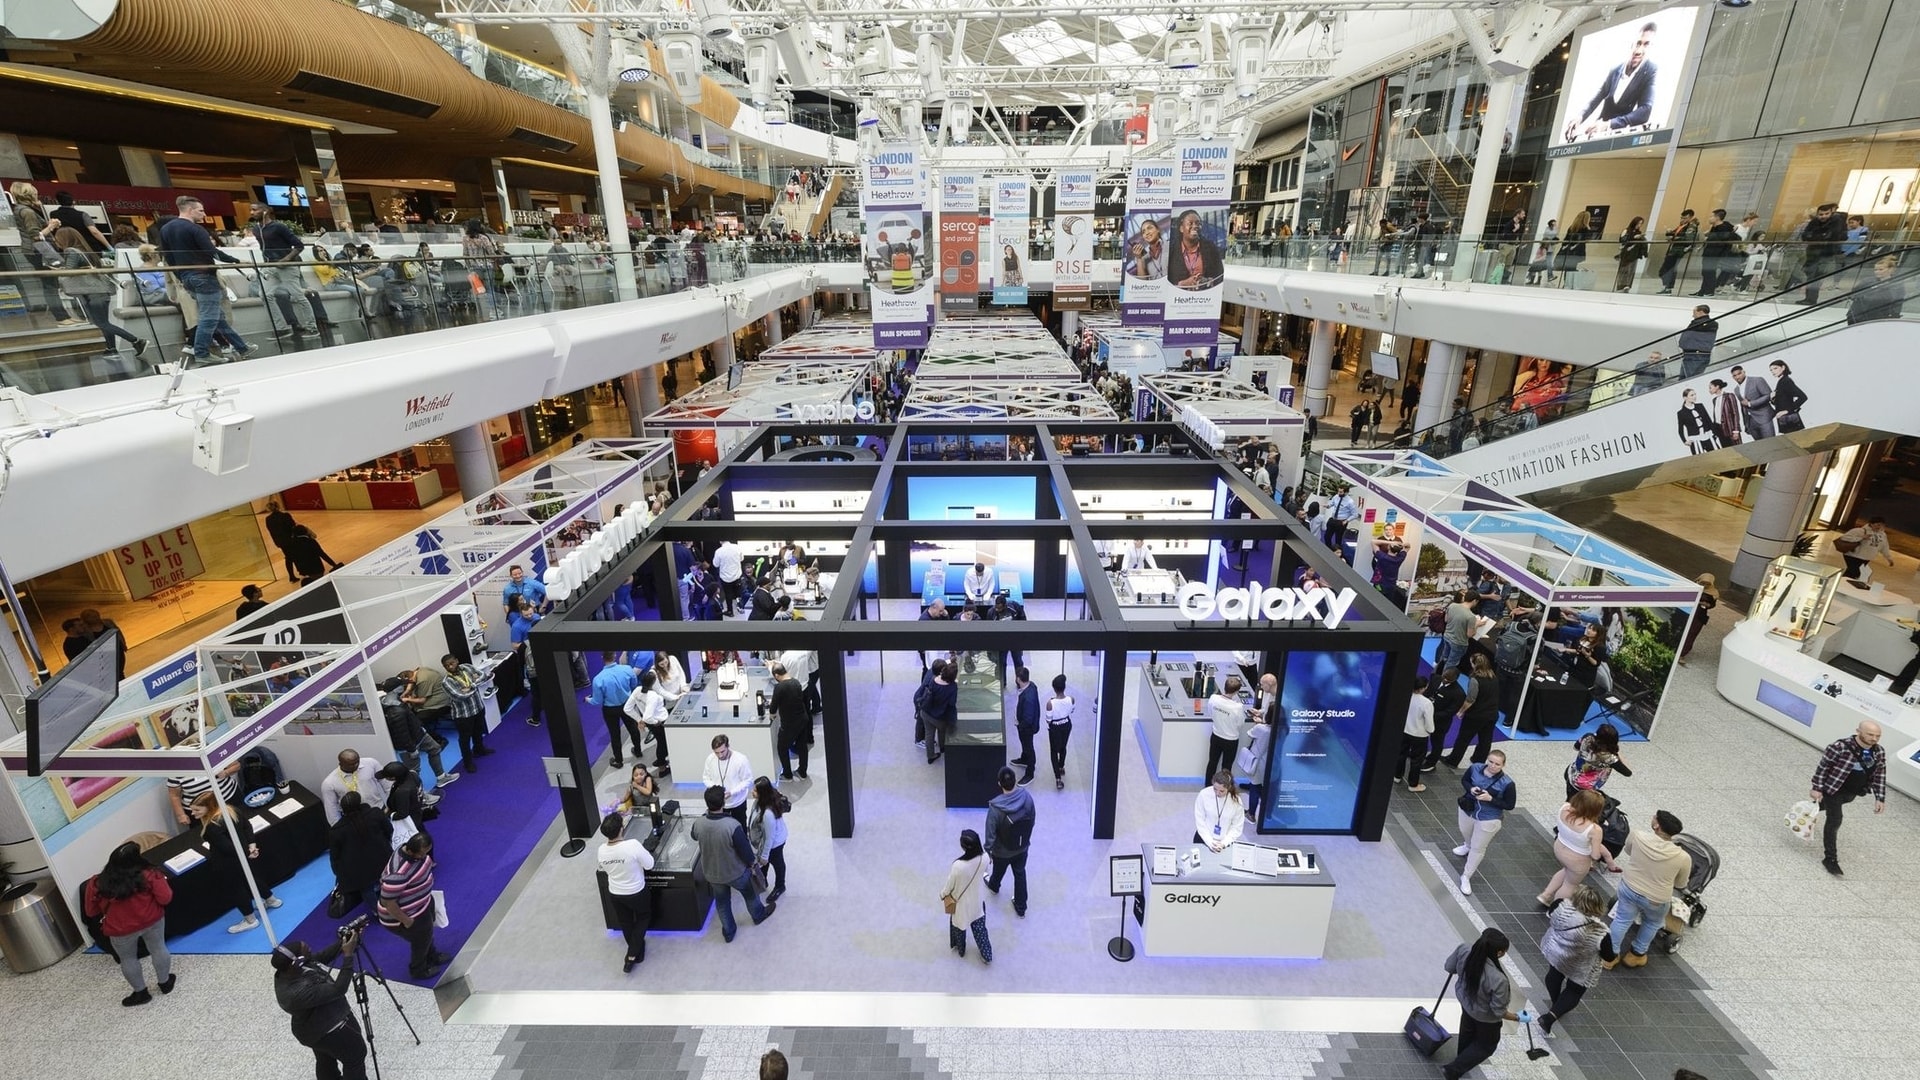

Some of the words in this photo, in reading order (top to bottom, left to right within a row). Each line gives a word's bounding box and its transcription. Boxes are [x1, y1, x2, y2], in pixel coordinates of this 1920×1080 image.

[1183, 147, 1228, 160] LONDON
[1550, 149, 1560, 157] LIFT
[1561, 147, 1577, 155] LOBBY
[1137, 168, 1173, 177] LONDON
[944, 176, 974, 185] LONDON
[1061, 175, 1091, 183] LONDON
[999, 182, 1026, 190] LONDON
[1179, 185, 1224, 195] Heathrow
[871, 189, 915, 200] Heathrow
[1135, 196, 1170, 205] Heathrow
[942, 222, 976, 233] serco
[1055, 260, 1091, 274] RISE
[1131, 283, 1161, 291] Heathrow
[881, 299, 917, 308] Heathrow
[1174, 296, 1212, 304] Heathrow
[880, 330, 895, 338] MAIN
[896, 329, 922, 338] SPONSOR
[1168, 327, 1184, 335] MAIN
[405, 391, 455, 418] Westfield
[404, 417, 431, 432] LONDON
[1522, 449, 1536, 459] WITH
[1537, 441, 1564, 454] ANTHONY
[1566, 433, 1590, 446] JOSHUA
[1475, 453, 1566, 487] ESTINATION
[1570, 431, 1647, 467] FASHION
[121, 527, 188, 566] SALE
[143, 560, 161, 578] UP
[165, 552, 183, 569] TO
[149, 574, 170, 591] 70%
[170, 568, 186, 582] OFF
[158, 599, 168, 609] NEW
[1175, 580, 1358, 630] Galaxy
[388, 630, 401, 640] Sports
[401, 617, 418, 631] Fashion
[151, 667, 183, 690] Allianz
[1291, 709, 1325, 719] Galaxy
[1326, 709, 1356, 718] Studio
[236, 731, 254, 747] Allianz
[254, 724, 264, 733] UK
[603, 858, 625, 866] Galaxy
[1164, 893, 1222, 907] Galaxy
